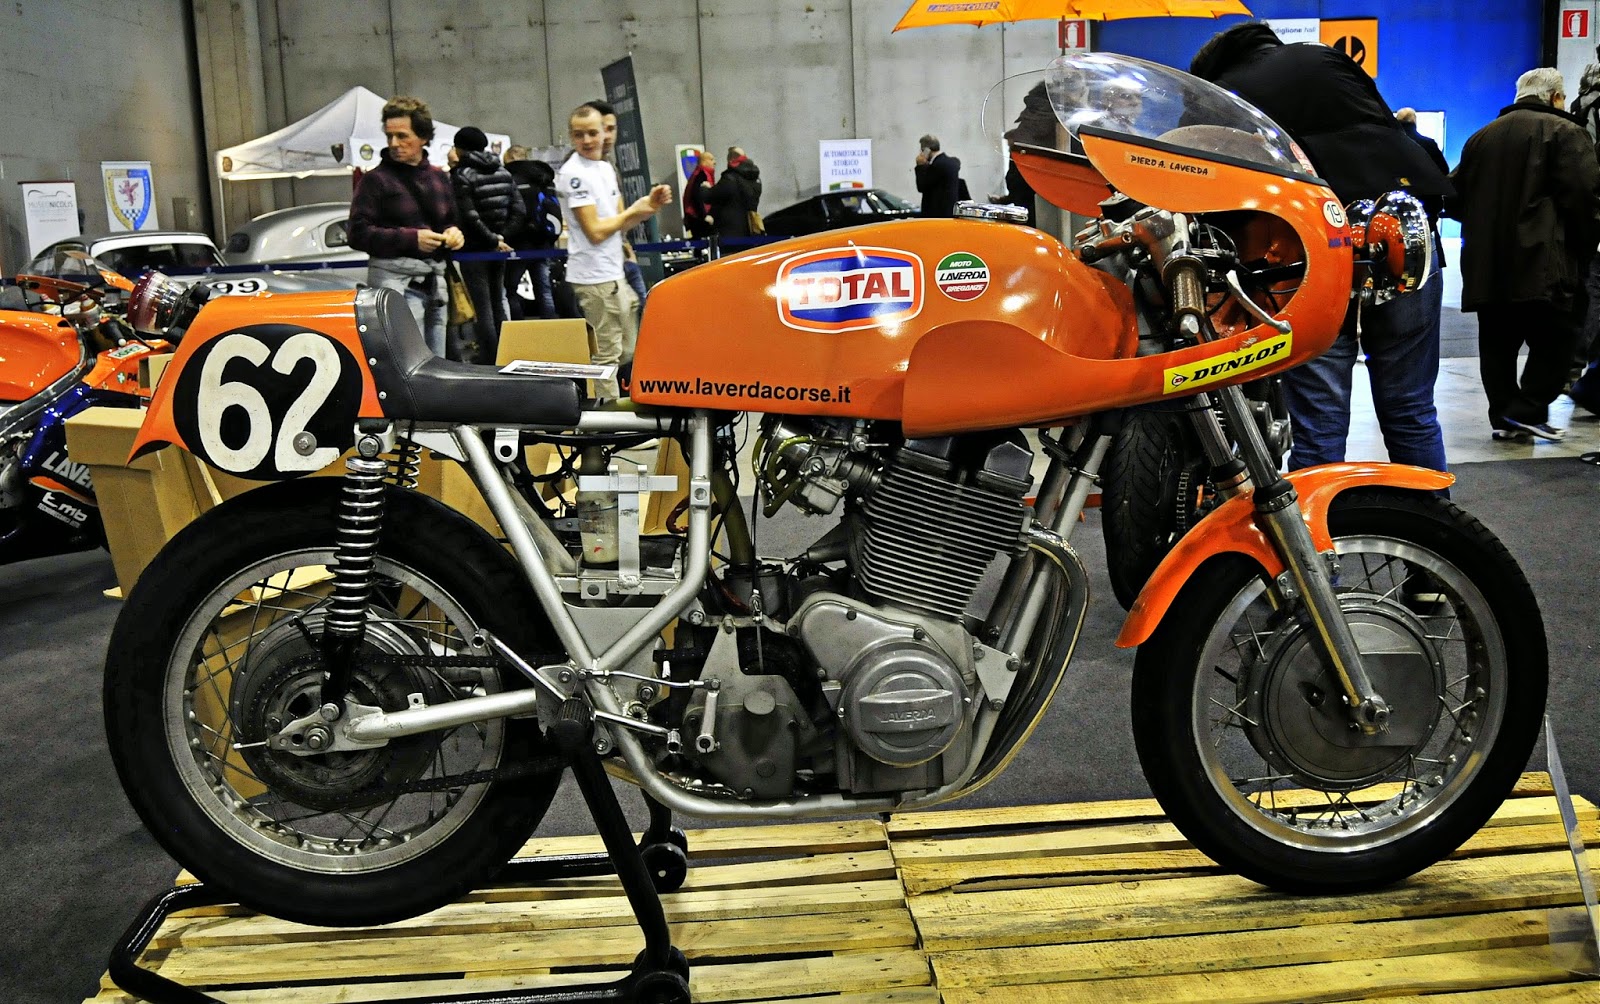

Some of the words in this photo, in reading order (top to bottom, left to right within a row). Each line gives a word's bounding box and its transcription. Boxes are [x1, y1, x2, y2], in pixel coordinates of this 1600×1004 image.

[831, 168, 862, 176] ITALIANO
[833, 159, 859, 167] STORICO
[1130, 155, 1157, 167] PIERO
[1169, 162, 1209, 176] LAVERDA
[1327, 203, 1343, 225] 19
[949, 260, 973, 268] MOTO
[939, 270, 987, 282] LAVERDA
[793, 271, 910, 305] TOTAL
[945, 284, 985, 293] BREGANZE
[1190, 341, 1287, 383] DUNLOP
[640, 378, 851, 403] www.laverdacorse.it
[197, 332, 342, 473] 62
